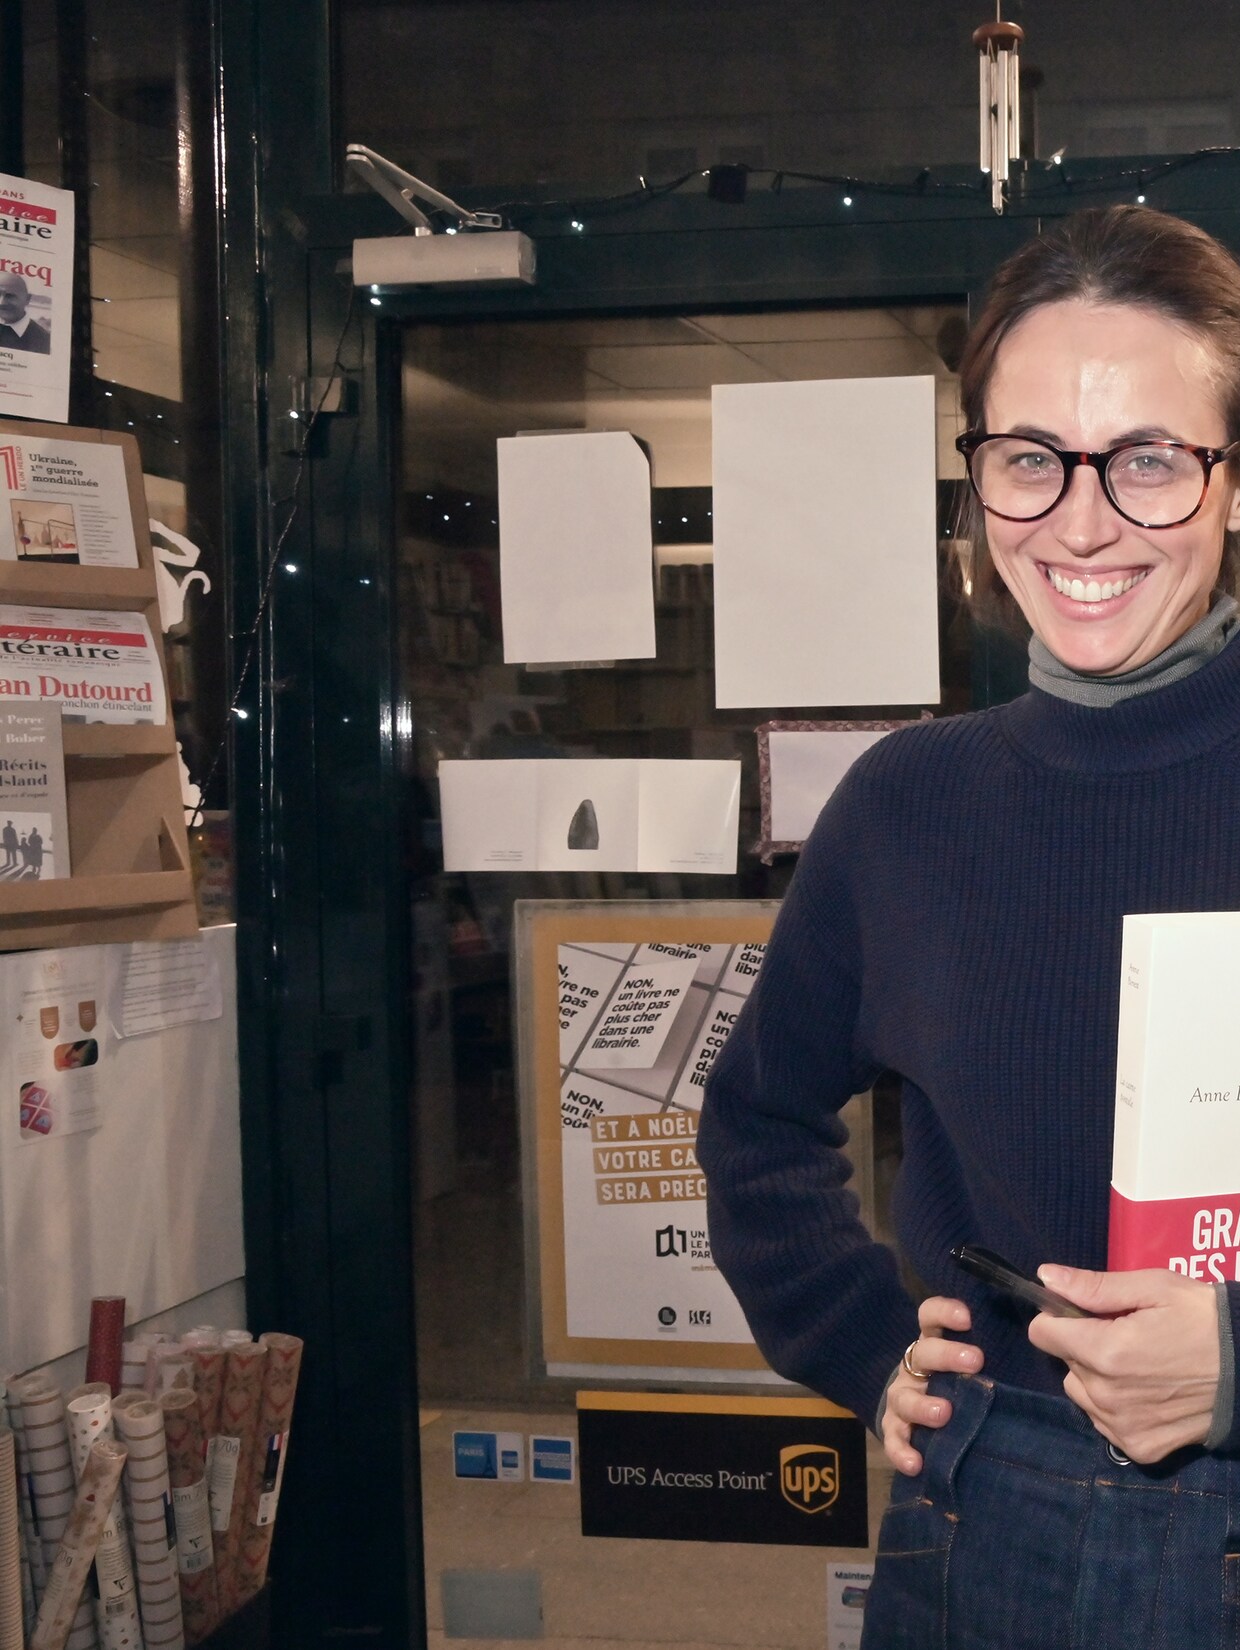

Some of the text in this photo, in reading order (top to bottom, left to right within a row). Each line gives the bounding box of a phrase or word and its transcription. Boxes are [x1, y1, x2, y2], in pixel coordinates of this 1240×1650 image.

[29, 454, 77, 467] Ukraine,
[47, 467, 83, 476] guerre
[32, 476, 99, 488] mondialisée
[1, 640, 120, 660] téraire
[38, 675, 153, 702] Dutourd
[580, 983, 600, 998] ne
[624, 978, 655, 990] NON,
[561, 993, 588, 1010] pas
[618, 988, 680, 1001] un livre ne
[612, 1000, 670, 1013] coûte pas
[604, 1011, 661, 1027] plus cher
[599, 1024, 654, 1037] dans une
[592, 1037, 641, 1049] librairie.
[567, 1090, 605, 1113] NON,
[1190, 1086, 1231, 1103] Anne
[596, 1113, 697, 1139] ET À NOËL
[598, 1149, 662, 1170] VOTRE
[601, 1183, 651, 1202] SERA
[691, 1230, 705, 1239] UN
[691, 1240, 702, 1249] LE
[607, 1466, 646, 1486] UPS
[651, 1468, 713, 1488] Access
[785, 1466, 834, 1502] ups
